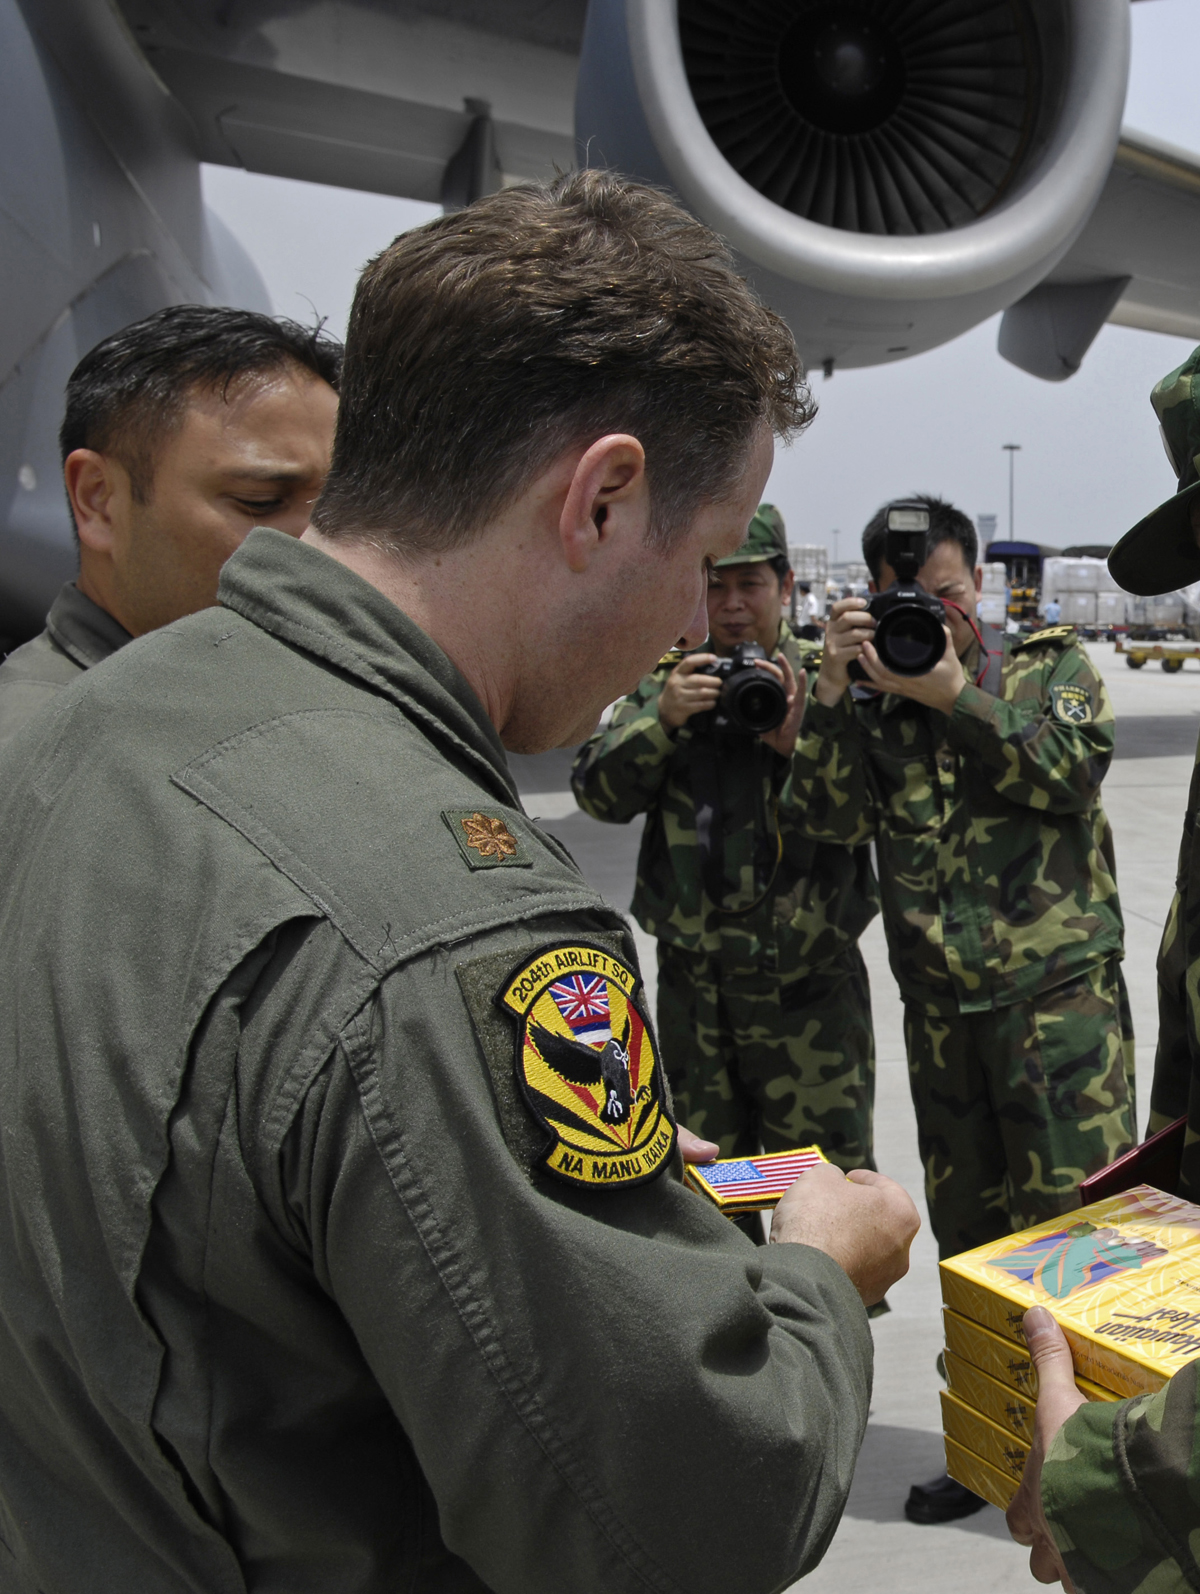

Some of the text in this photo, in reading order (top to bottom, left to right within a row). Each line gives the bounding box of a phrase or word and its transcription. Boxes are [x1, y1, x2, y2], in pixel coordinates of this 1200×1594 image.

[513, 951, 629, 1004] 204th AIRLIFT SQ
[557, 1152, 584, 1176] NA
[591, 1157, 642, 1179] MANU
